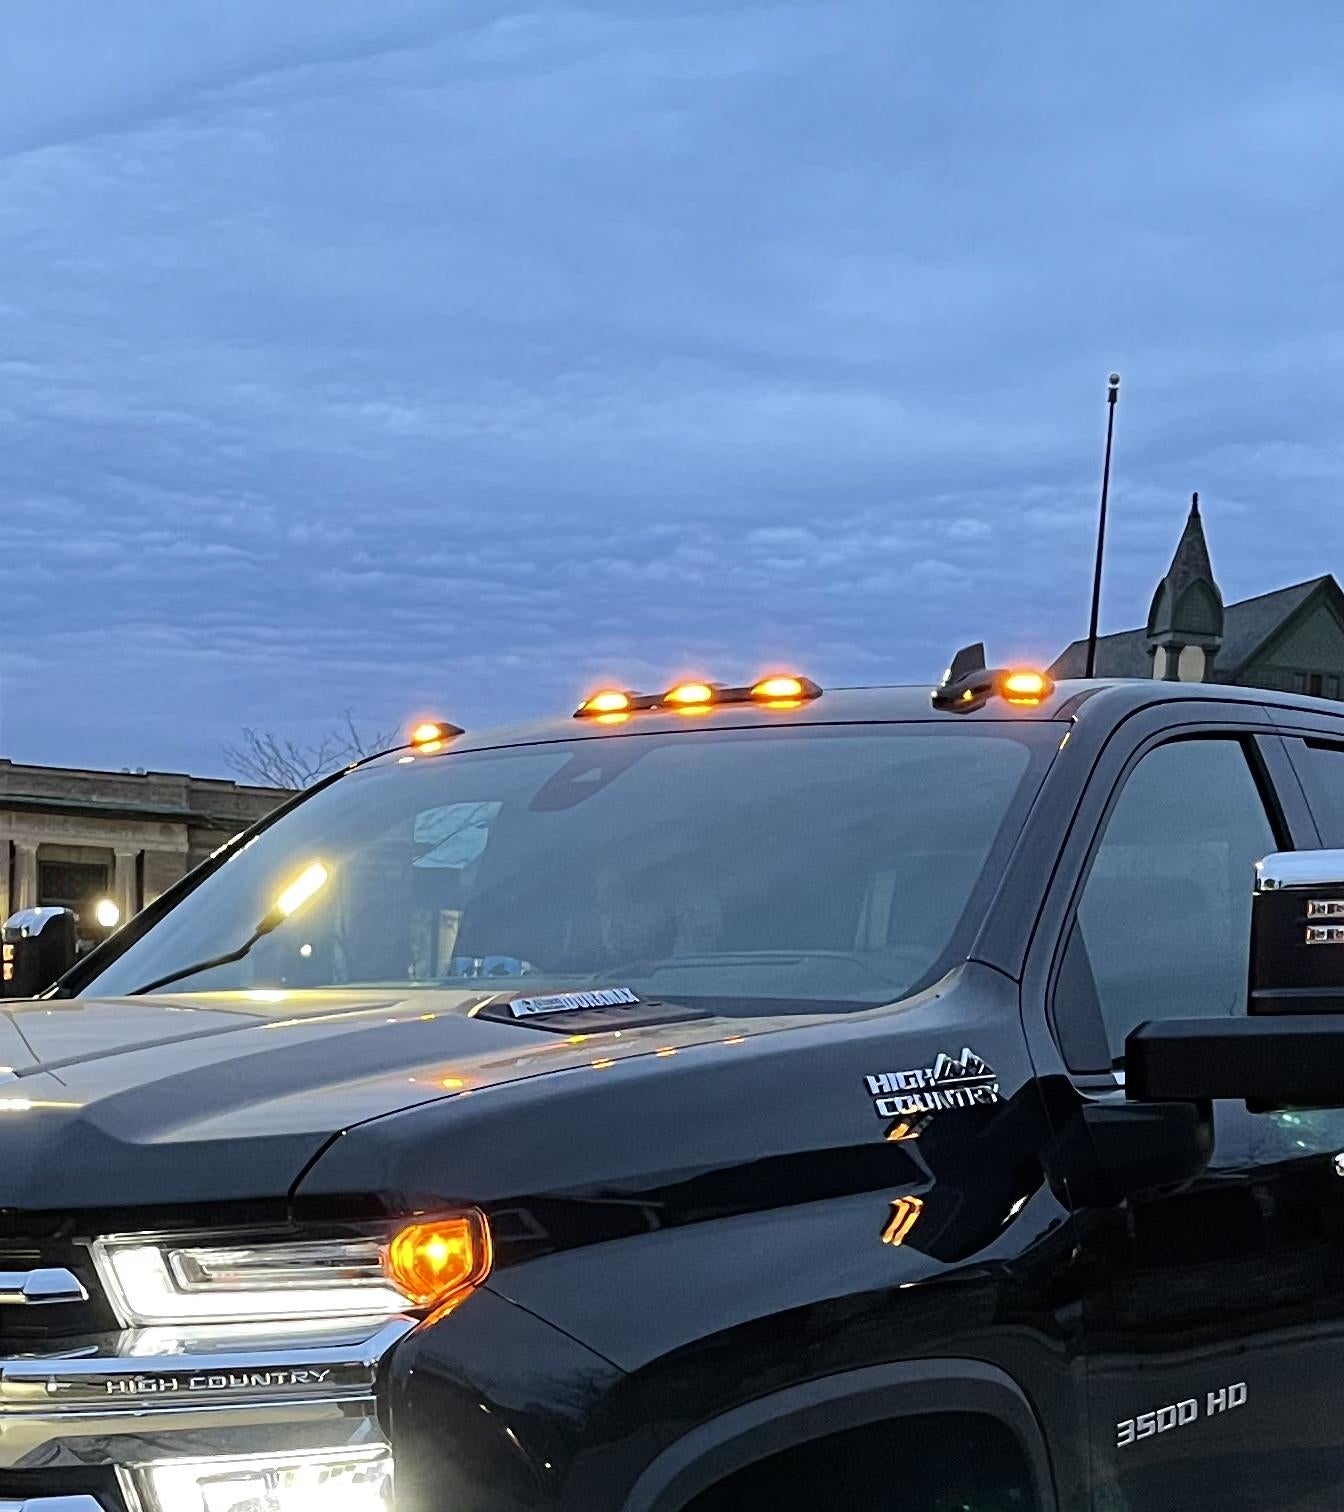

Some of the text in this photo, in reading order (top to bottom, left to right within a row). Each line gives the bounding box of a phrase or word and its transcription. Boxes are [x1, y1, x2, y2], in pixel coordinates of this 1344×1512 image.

[866, 1068, 936, 1095] HIGH
[875, 1083, 999, 1117] COUNTRY
[106, 1368, 331, 1394] HIGH COUNTRY
[1116, 1381, 1248, 1448] 3500 HD
